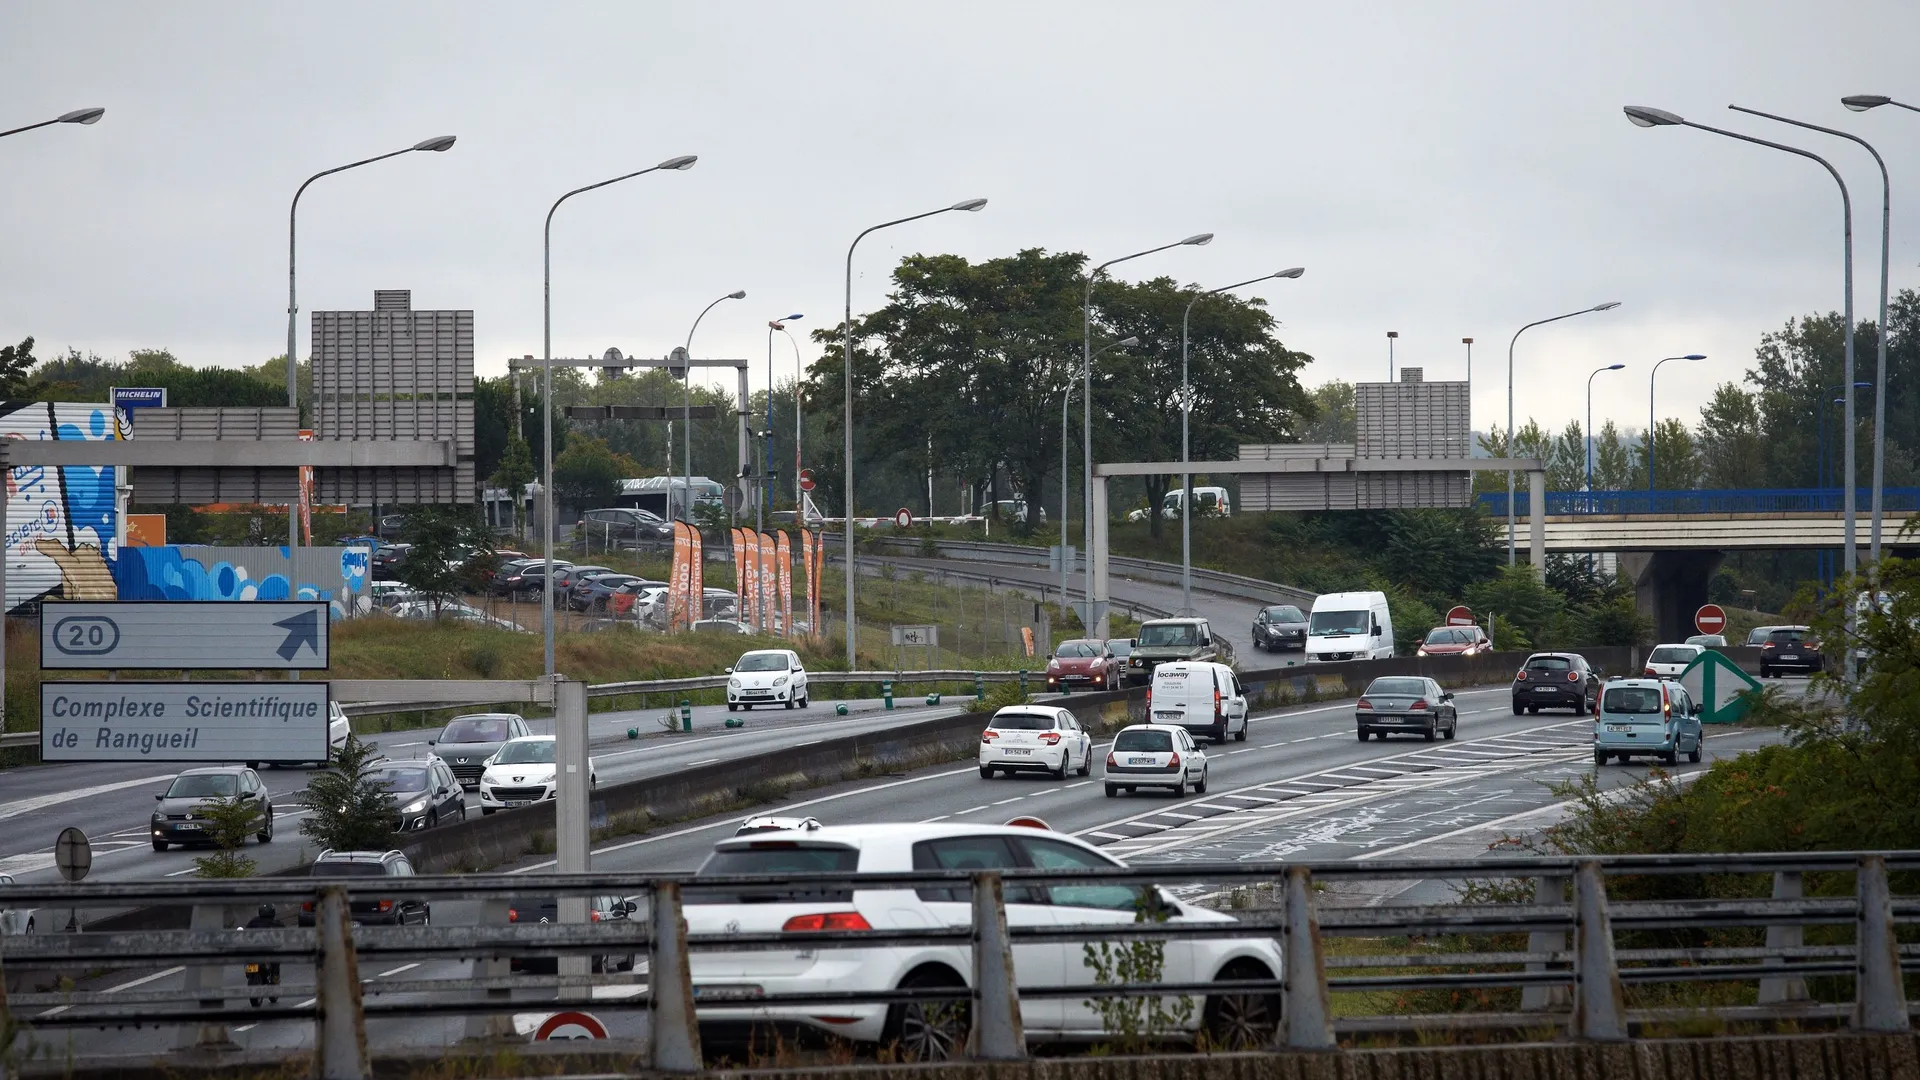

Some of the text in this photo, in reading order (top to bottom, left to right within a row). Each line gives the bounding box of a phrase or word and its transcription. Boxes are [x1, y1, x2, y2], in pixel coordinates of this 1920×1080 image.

[69, 625, 104, 646] 20
[1157, 671, 1190, 680] locaway
[52, 695, 319, 723] Complexe Scientifique
[52, 727, 199, 755] de Rangueil
